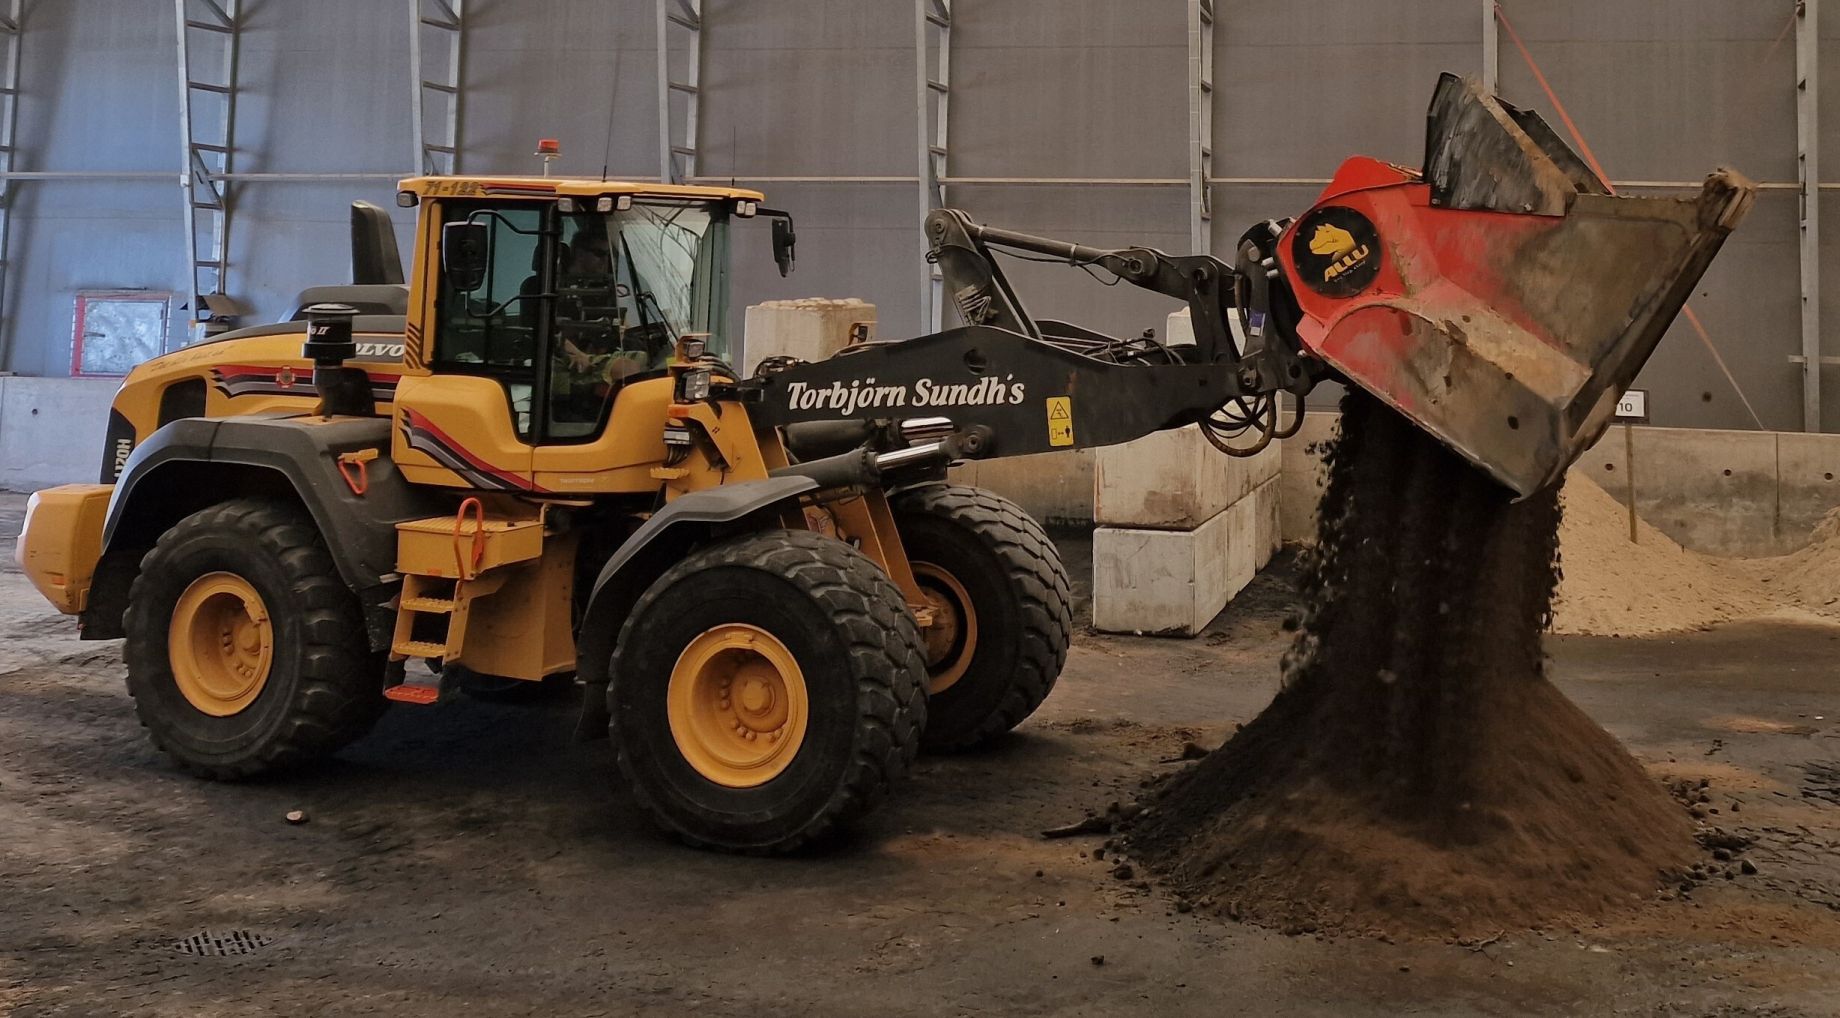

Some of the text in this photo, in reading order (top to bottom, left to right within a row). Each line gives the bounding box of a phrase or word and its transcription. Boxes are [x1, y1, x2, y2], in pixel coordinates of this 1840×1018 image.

[1324, 244, 1369, 283] ALLU
[356, 343, 405, 357] LVO
[787, 377, 907, 416] Torbjörn
